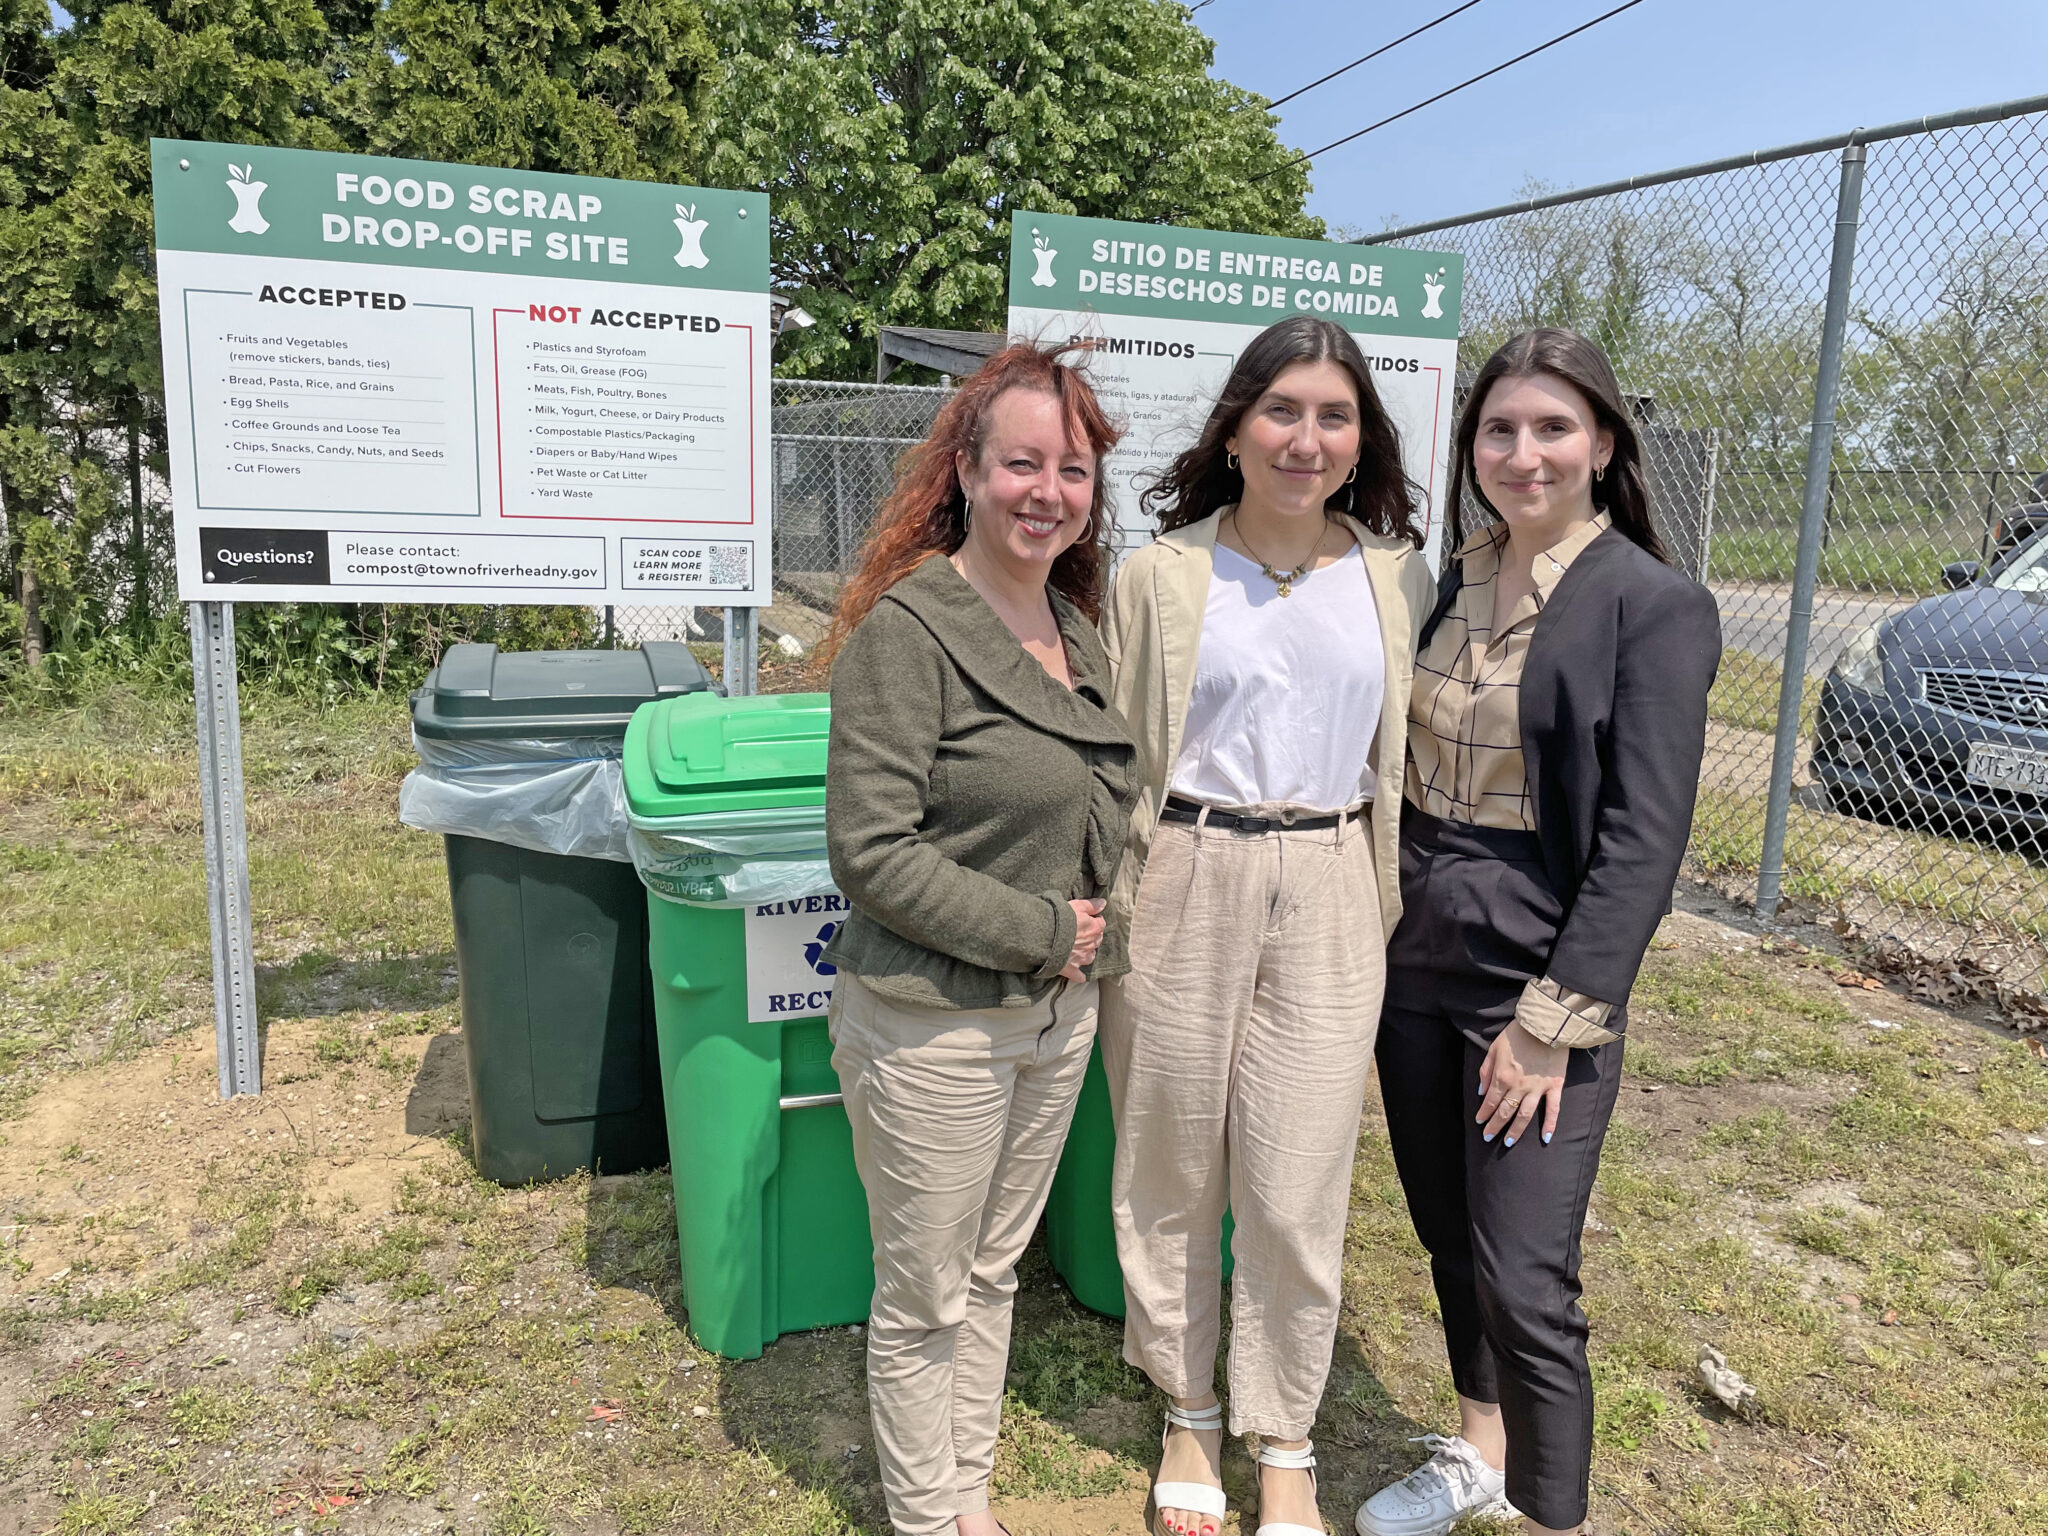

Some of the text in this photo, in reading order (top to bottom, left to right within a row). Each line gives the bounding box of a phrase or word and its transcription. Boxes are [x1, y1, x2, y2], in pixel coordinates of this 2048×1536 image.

[336, 172, 602, 222] FOOD SCRAP
[321, 213, 629, 265] DROP-OFF SITE
[1092, 239, 1383, 287] SITIO DE ENTREGA DE
[258, 285, 407, 311] ACCEPTED
[1078, 269, 1400, 318] DESESCHOS DE COMIDA
[529, 304, 721, 334] NOT ACCEPTED
[226, 333, 349, 350] Fruits and Vegetables
[533, 342, 647, 358] Plastics and Styrofoam
[229, 352, 390, 370] (remove stickers, bands, ties)
[1364, 356, 1419, 373] TIDOS
[533, 364, 648, 379] Fats, Oil, Grease (FOG)
[229, 375, 395, 393] Bread, Pasta, Rice, and Grains
[534, 385, 668, 400] Meats, Fish, Poultry, Bones
[1131, 391, 1152, 400] ligas,
[1160, 393, 1198, 403] ataduras)
[230, 398, 290, 410] Egg Shells
[535, 405, 725, 423] Milk, Yogurt, Cheese, or Dairy Products
[1133, 411, 1162, 420] Granos
[232, 419, 401, 435] Coffee Grounds and Loose Tea
[535, 426, 695, 443] Compostable Plastics/Packaging
[233, 441, 444, 459] Chips, Snacks, Candy, Nuts, and Seeds
[536, 447, 575, 459] Diapers
[590, 449, 646, 462] Baby/Hand
[648, 451, 678, 462] Wipes
[1143, 451, 1149, 459] y
[1150, 449, 1173, 459] Hojas
[234, 463, 301, 475] Cut Flowers
[537, 468, 648, 480] Pet Waste or Cat Litter
[537, 488, 593, 499] Yard Waste
[216, 548, 314, 567] Questions?
[346, 543, 461, 558] Please contact:
[639, 548, 702, 559] SCAN CODE
[346, 561, 598, 579] compost@townofriverheadny.gov
[633, 560, 702, 570] LEARN MORE
[637, 572, 702, 582] & REGISTER!
